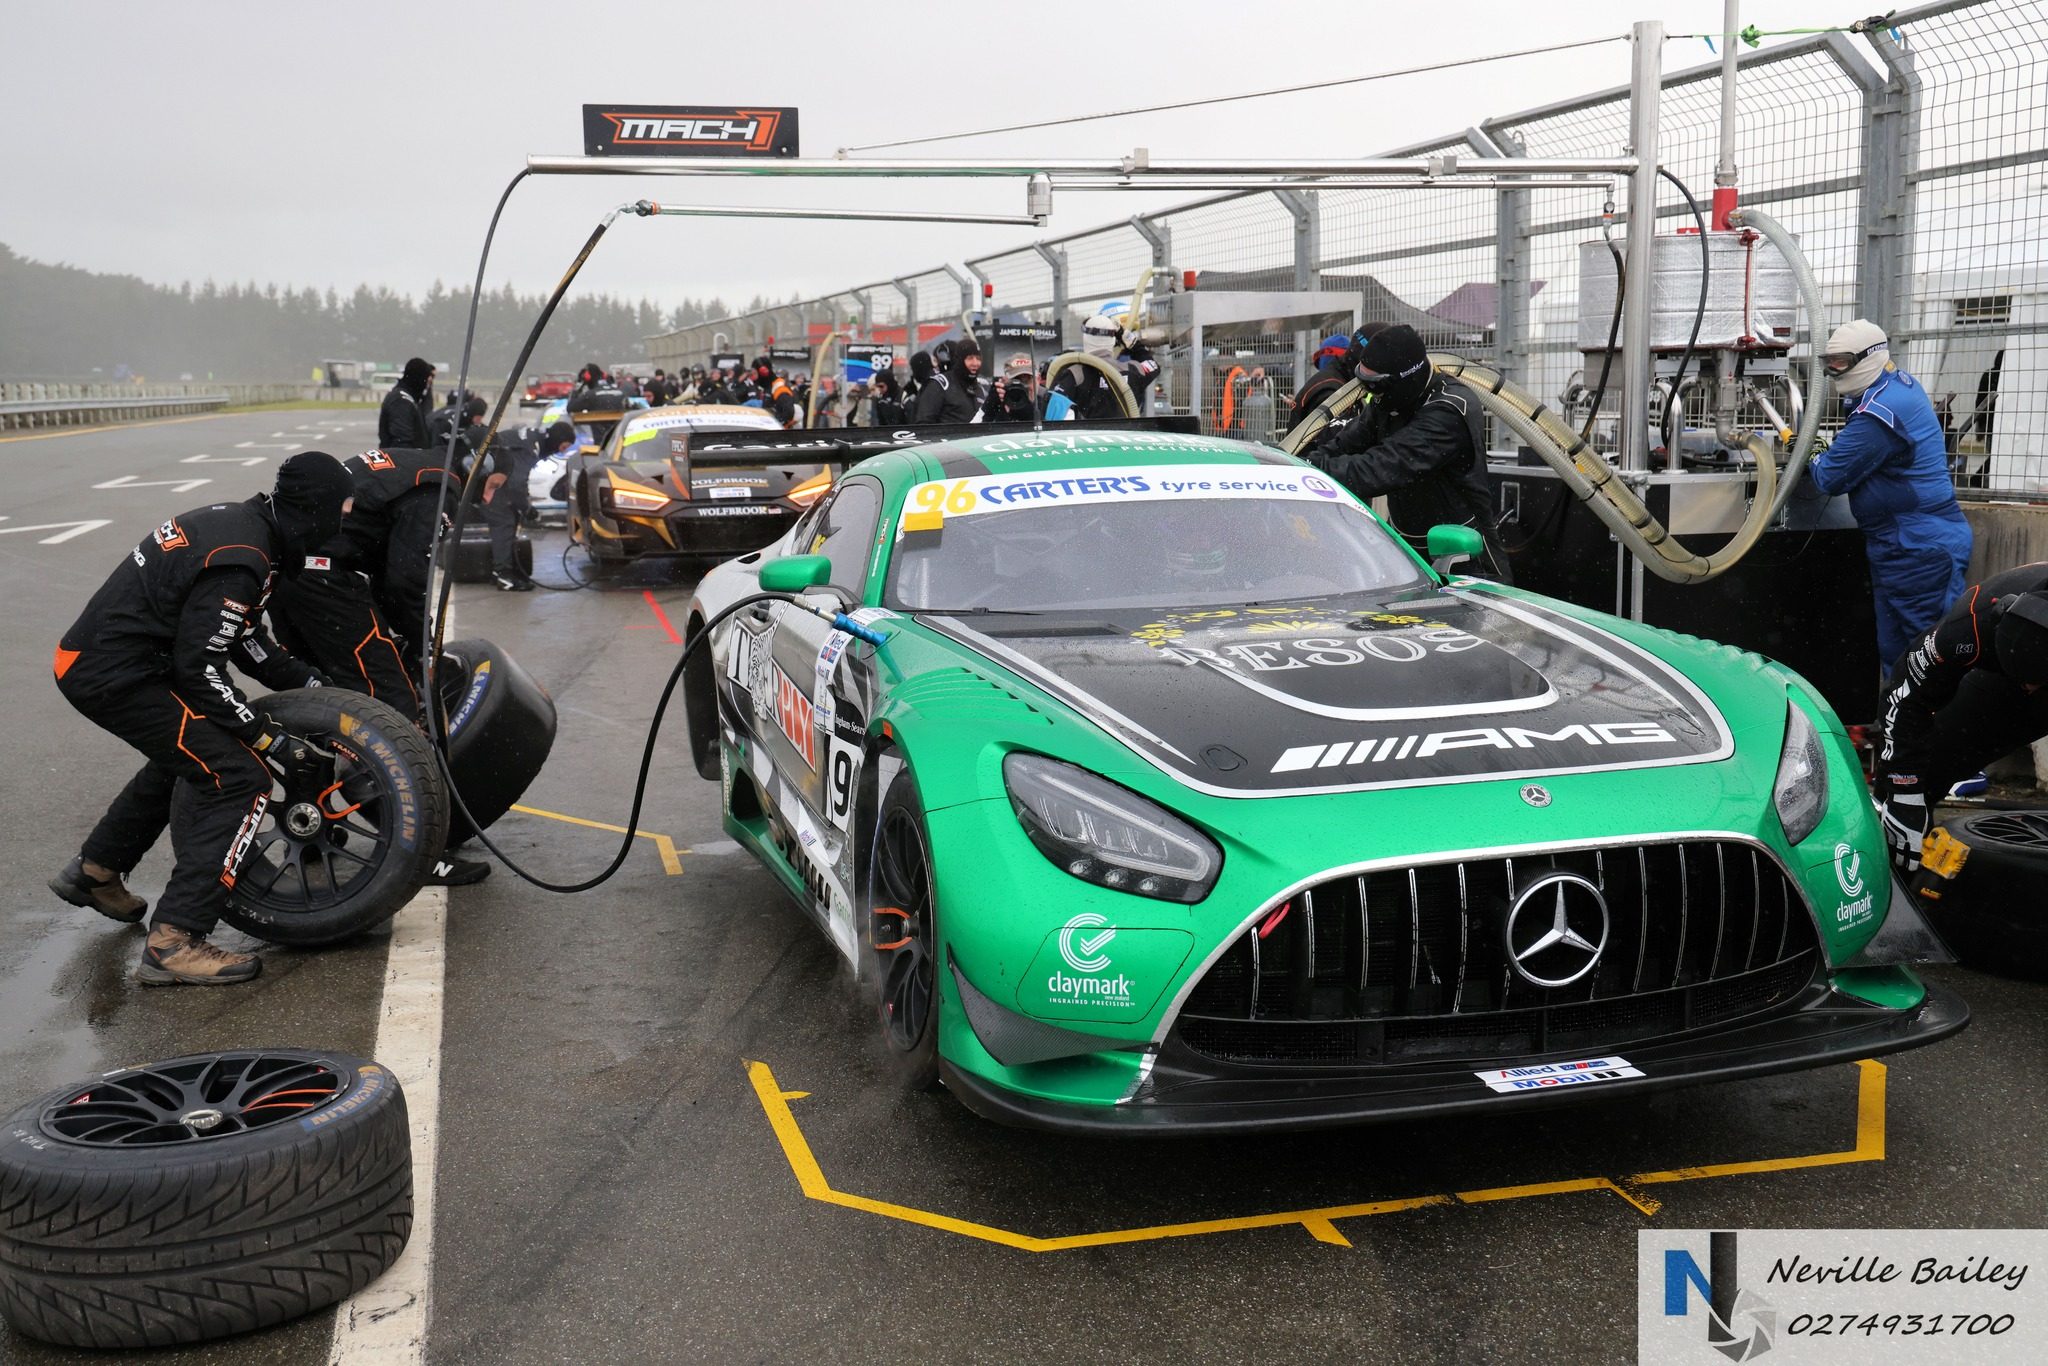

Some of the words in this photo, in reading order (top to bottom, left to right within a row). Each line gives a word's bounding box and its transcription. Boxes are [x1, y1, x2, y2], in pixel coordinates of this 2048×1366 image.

[1000, 328, 1020, 336] JAMES
[871, 354, 892, 370] 89
[998, 446, 1109, 461] INGRAINED
[1121, 444, 1223, 453] PRECISION
[915, 480, 977, 513] 96
[980, 476, 1152, 505] CARTER'S
[1160, 479, 1212, 494] tyre
[1219, 480, 1299, 494] service
[698, 506, 768, 517] WOLFBROOK
[1413, 721, 1676, 757] AMG
[370, 742, 417, 842] MICHELIN
[1836, 890, 1872, 923] claymark
[1048, 970, 1130, 999] claymark
[1049, 997, 1088, 1005] INGRAINED
[1091, 999, 1130, 1007] PRECISION
[1500, 1065, 1557, 1079] Allied
[1512, 1074, 1592, 1089] Mobil
[311, 1078, 379, 1126] MICHELIN
